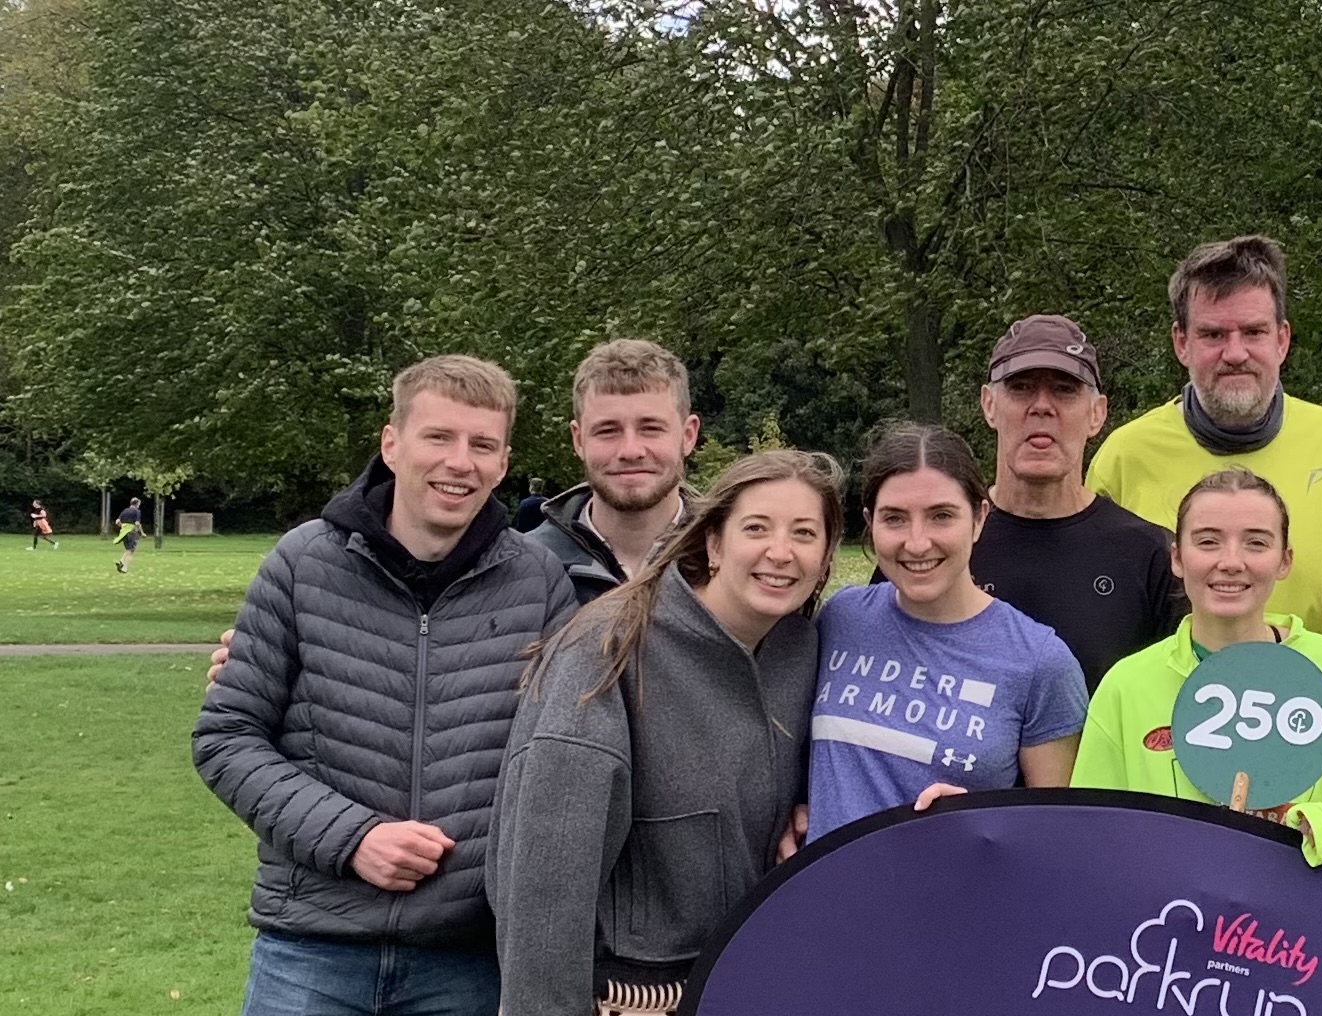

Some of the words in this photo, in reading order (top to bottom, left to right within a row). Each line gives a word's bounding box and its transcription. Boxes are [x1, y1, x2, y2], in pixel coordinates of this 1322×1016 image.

[829, 650, 957, 697] UNDER
[817, 681, 987, 742] ARMOUR
[1206, 960, 1250, 977] partners
[1212, 912, 1320, 986] Vitality
